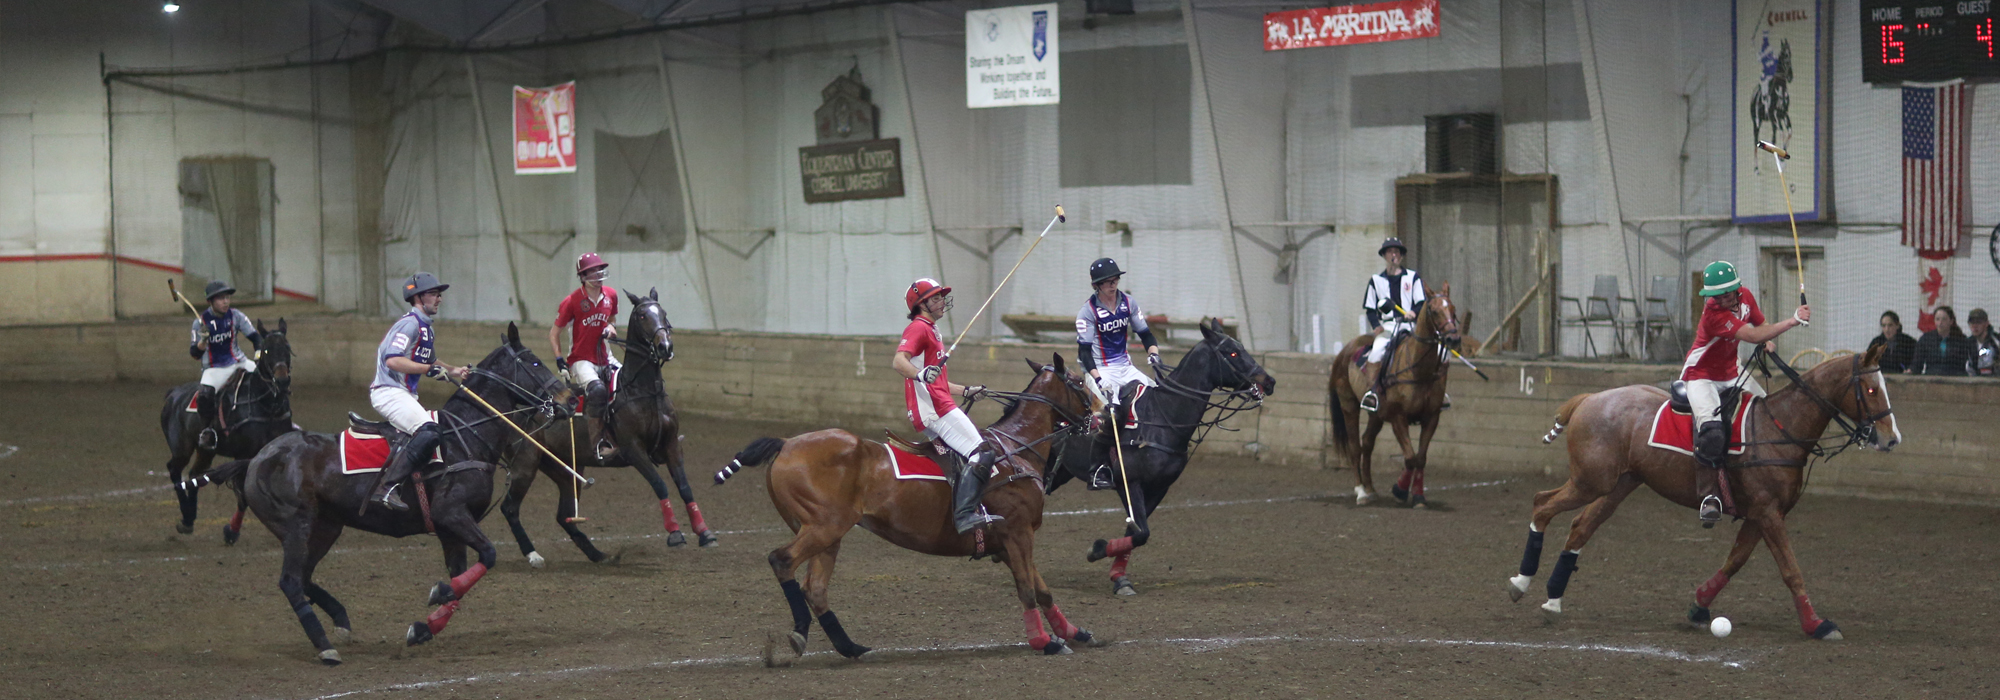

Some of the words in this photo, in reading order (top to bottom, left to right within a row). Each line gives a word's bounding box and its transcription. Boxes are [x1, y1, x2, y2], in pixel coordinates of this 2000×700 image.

[1872, 7, 1902, 20] HOME
[1915, 6, 1943, 18] PERIOD
[1957, 1, 1991, 15] GUEST
[1293, 17, 1317, 40] LA
[1319, 9, 1411, 38] MARTINA
[1976, 18, 1993, 58] 4
[970, 56, 991, 69] Sharing
[994, 55, 1004, 66] the
[1006, 54, 1025, 65] Dream
[981, 72, 1004, 85] Working
[1006, 71, 1032, 84] together
[1035, 69, 1046, 80] and
[993, 88, 1016, 101] Building
[1019, 87, 1030, 98] the
[811, 174, 845, 194] CORNELL
